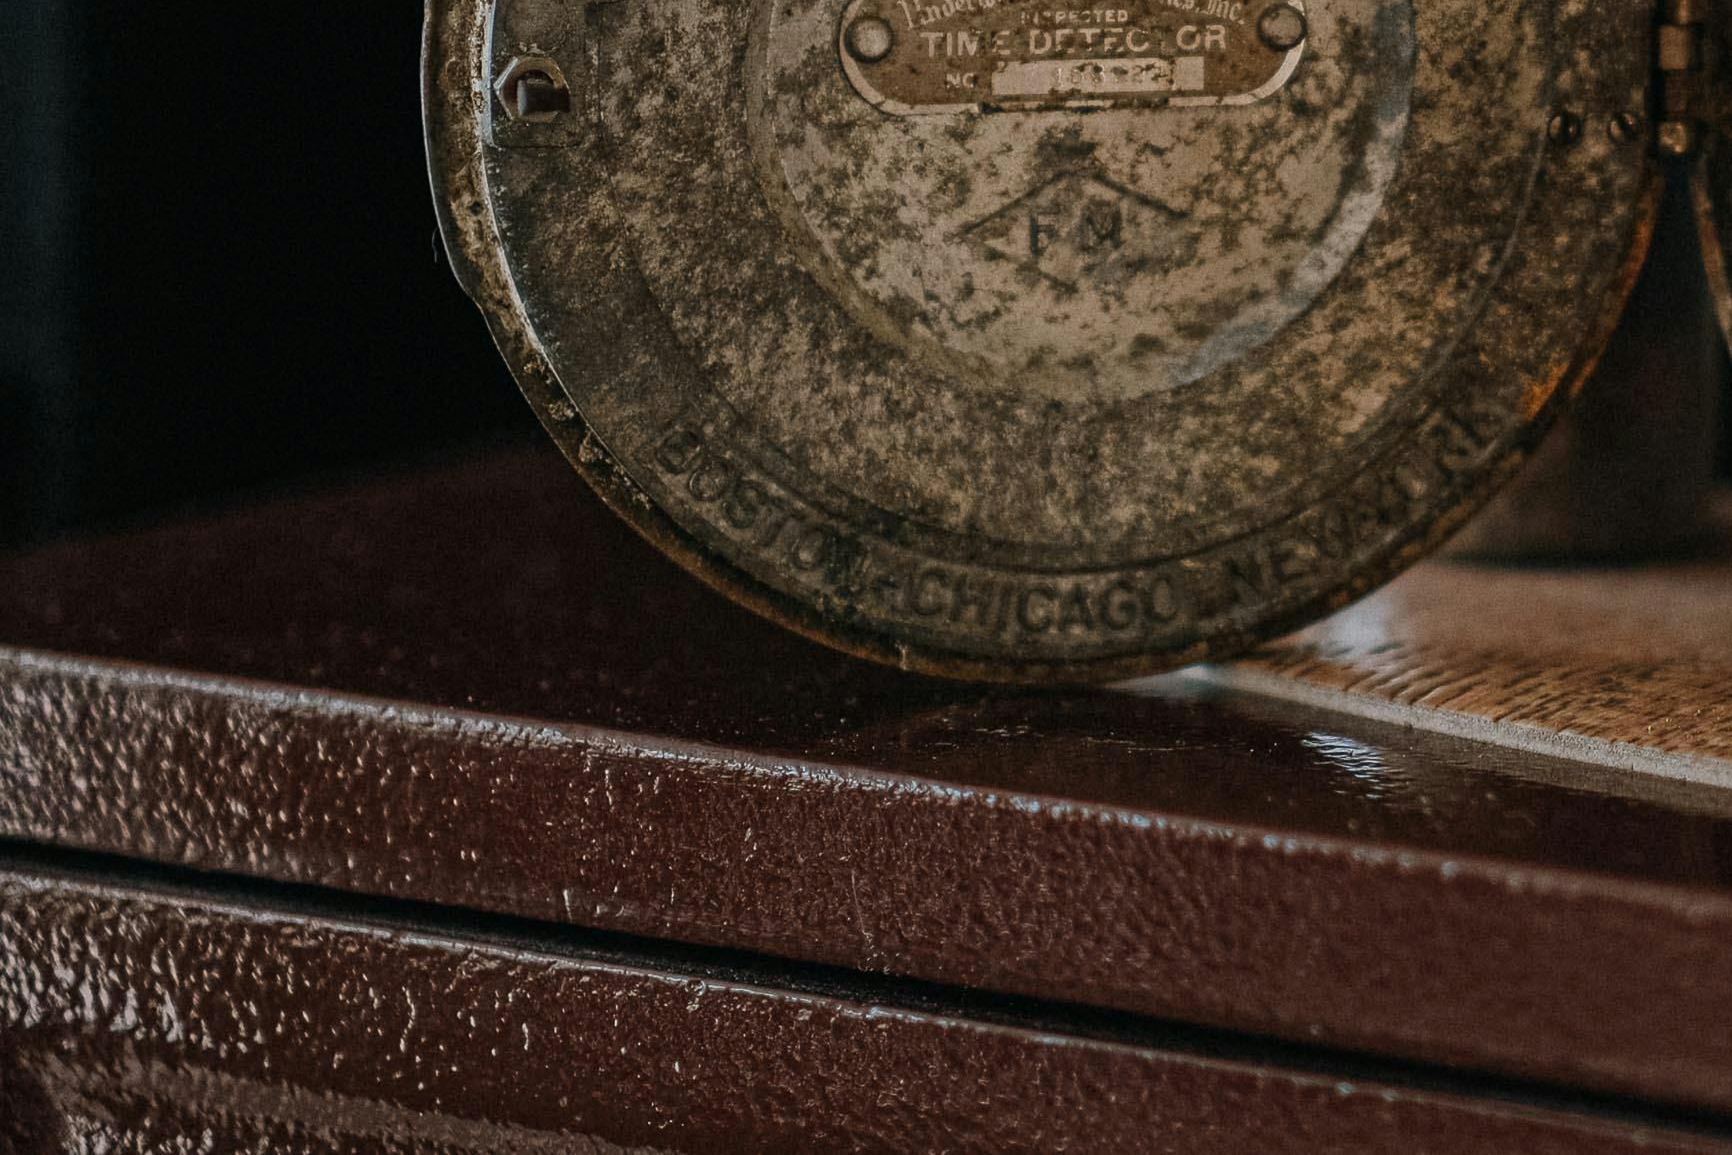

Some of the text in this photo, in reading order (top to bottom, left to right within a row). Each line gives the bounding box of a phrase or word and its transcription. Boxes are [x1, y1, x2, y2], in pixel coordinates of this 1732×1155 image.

[920, 24, 1227, 58] TIME DETECOR
[908, 568, 1179, 633] CHICAGO
